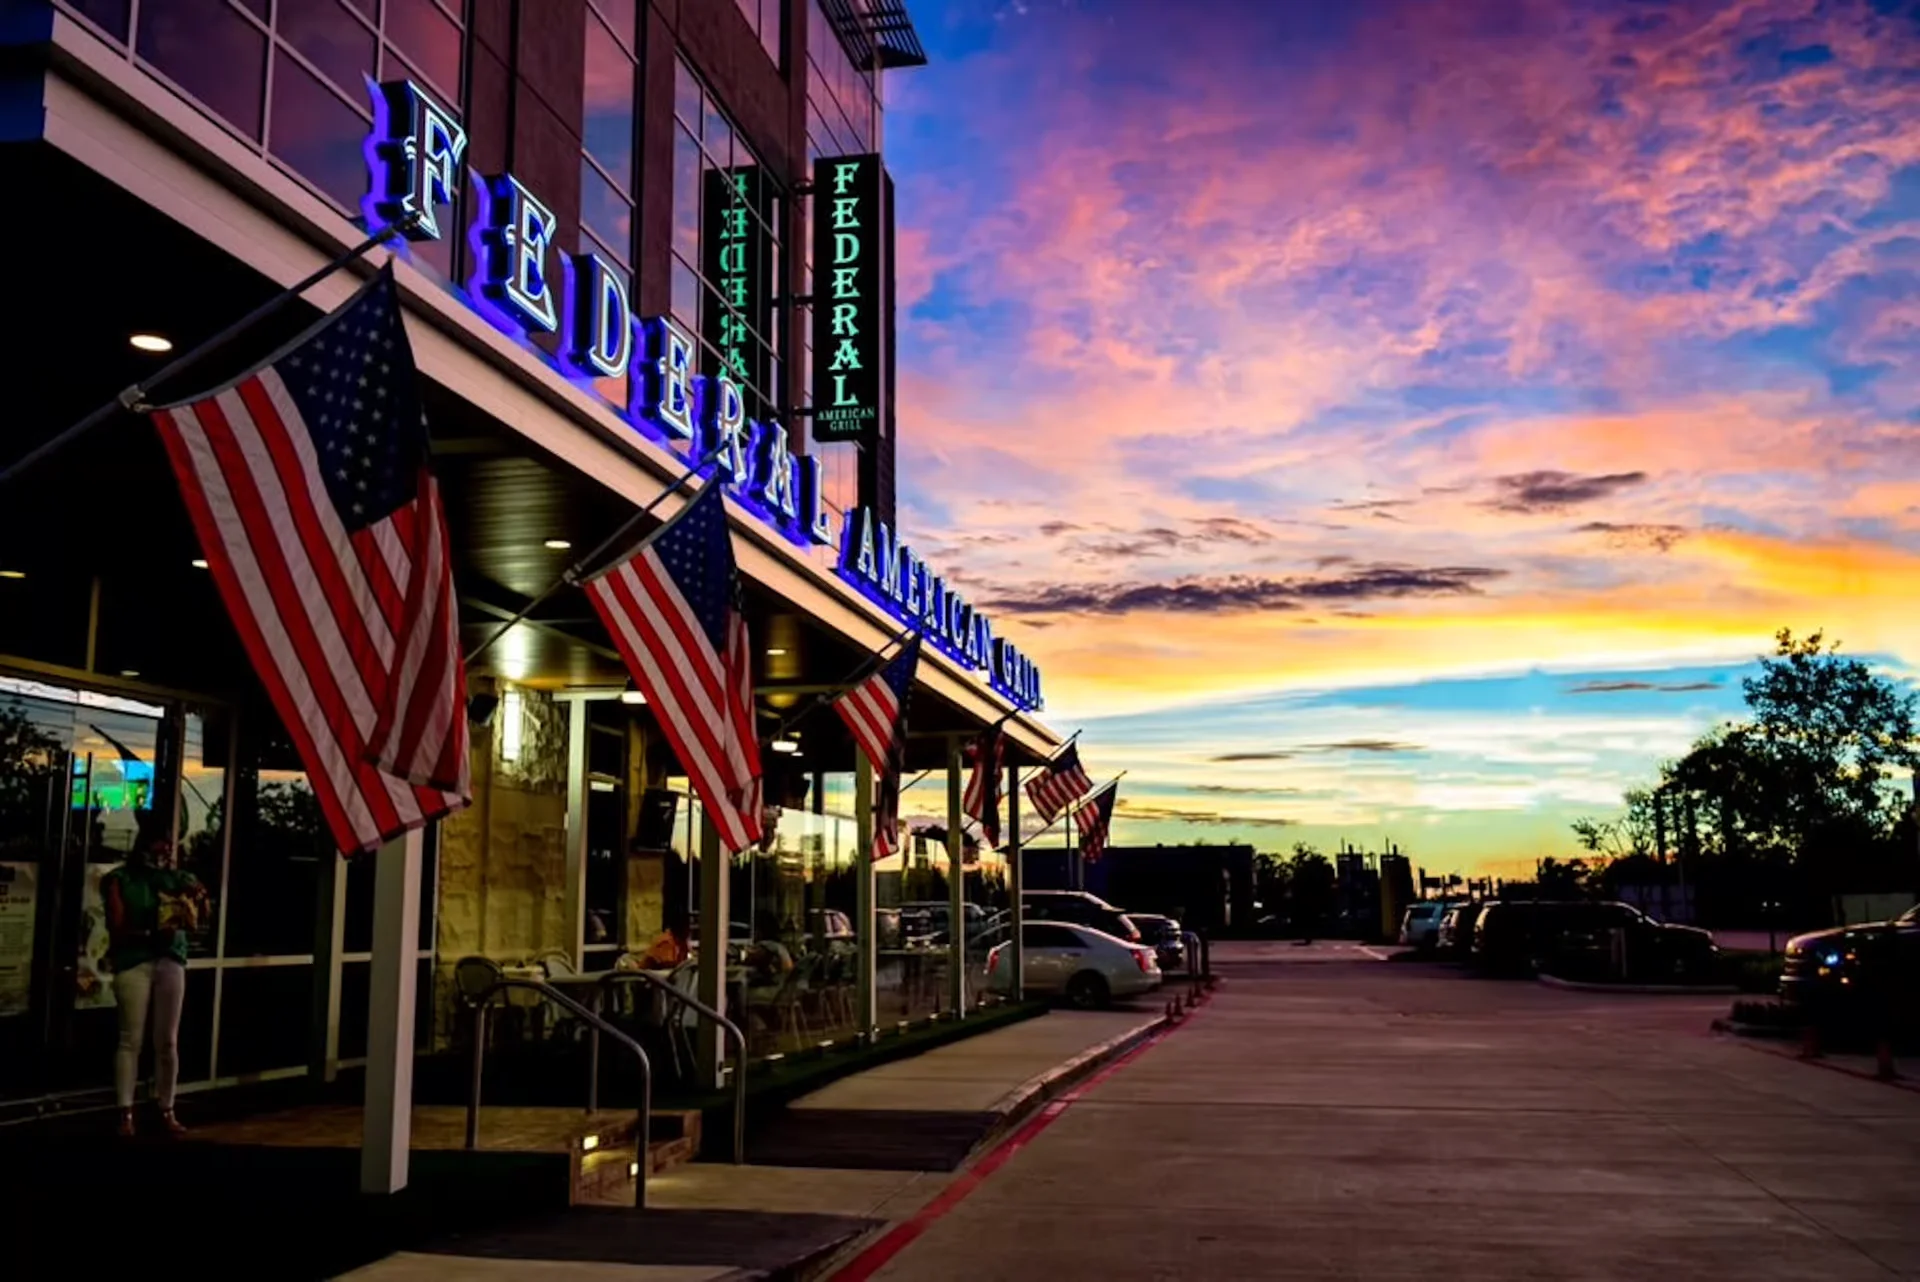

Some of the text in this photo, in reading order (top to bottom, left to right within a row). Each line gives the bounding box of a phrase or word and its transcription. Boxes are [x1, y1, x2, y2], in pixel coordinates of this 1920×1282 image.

[827, 162, 864, 406] FEDERAL
[400, 79, 1045, 711] FEDERAL AMERICAN GRILL
[816, 406, 875, 420] AMERICAN
[829, 418, 863, 431] GRILL
